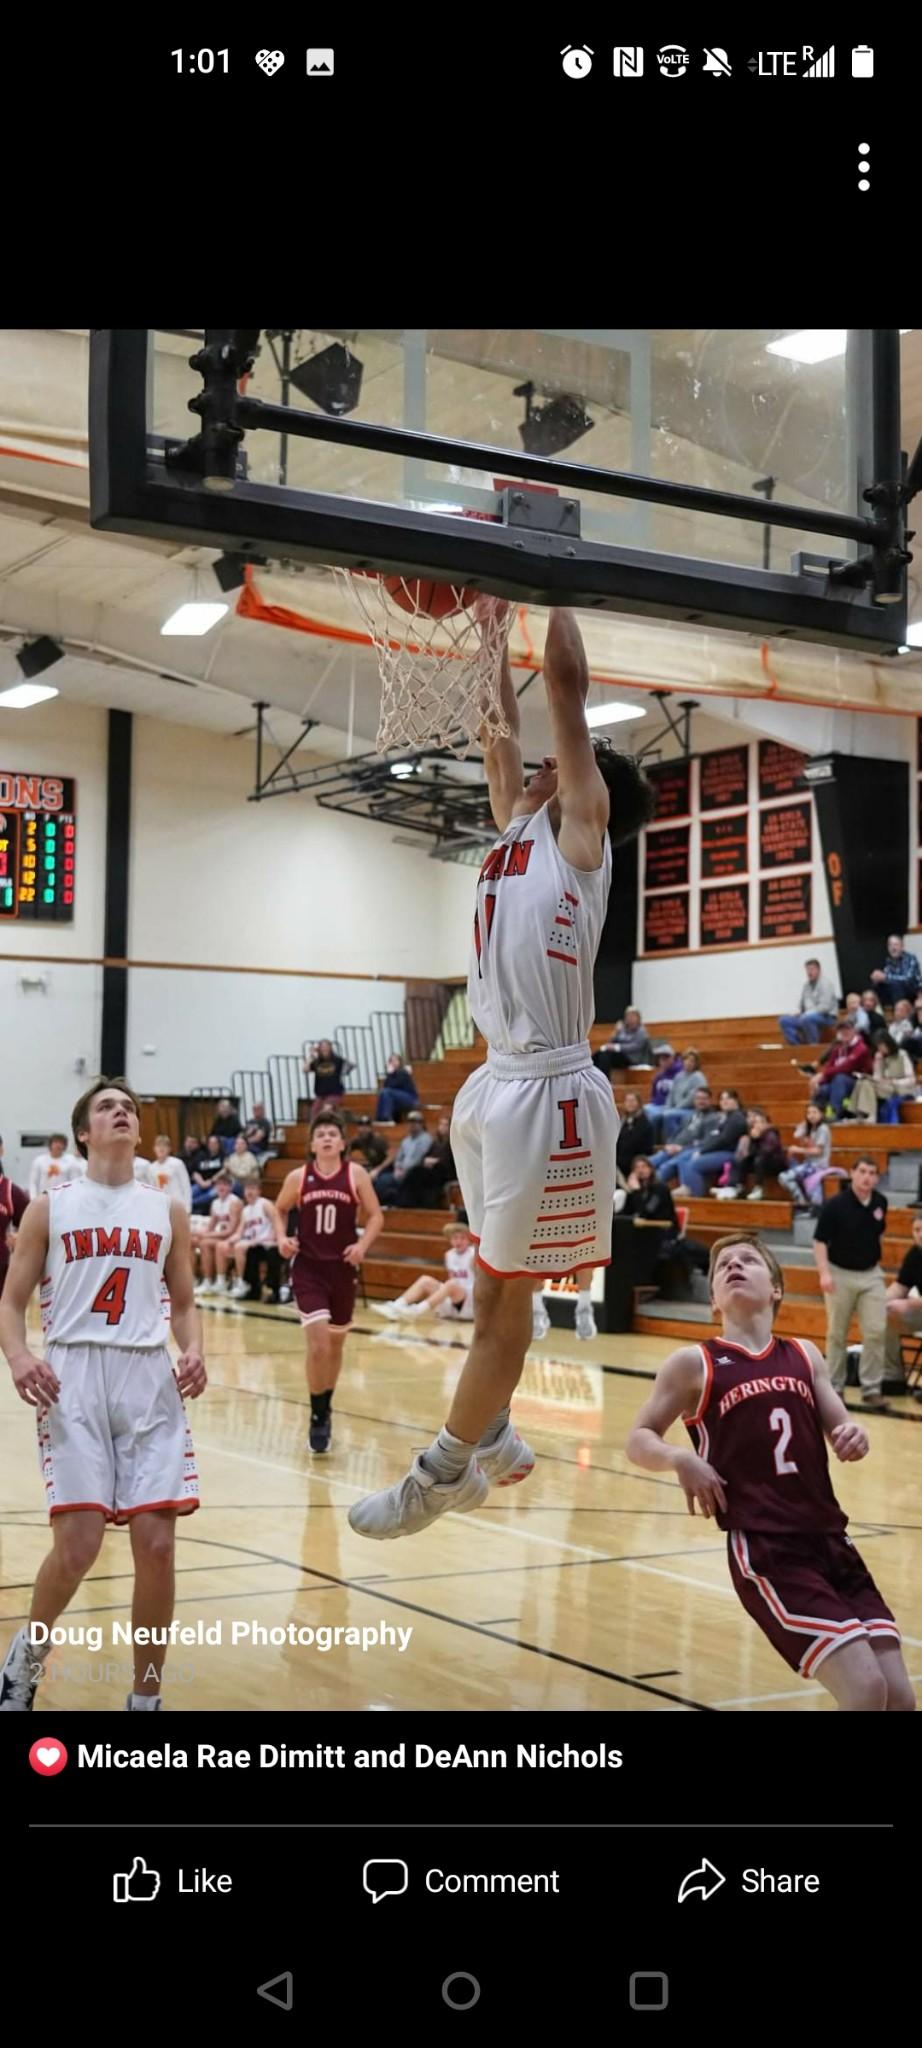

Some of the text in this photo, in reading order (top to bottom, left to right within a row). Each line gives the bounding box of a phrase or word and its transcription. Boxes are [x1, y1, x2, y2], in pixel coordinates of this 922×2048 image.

[26, 821, 36, 836] 2
[19, 887, 36, 902] 22
[558, 1099, 582, 1149] I
[315, 1204, 337, 1235] 10
[61, 1227, 163, 1264] INMAN
[91, 1267, 131, 1325] 4
[769, 1407, 799, 1476] 2
